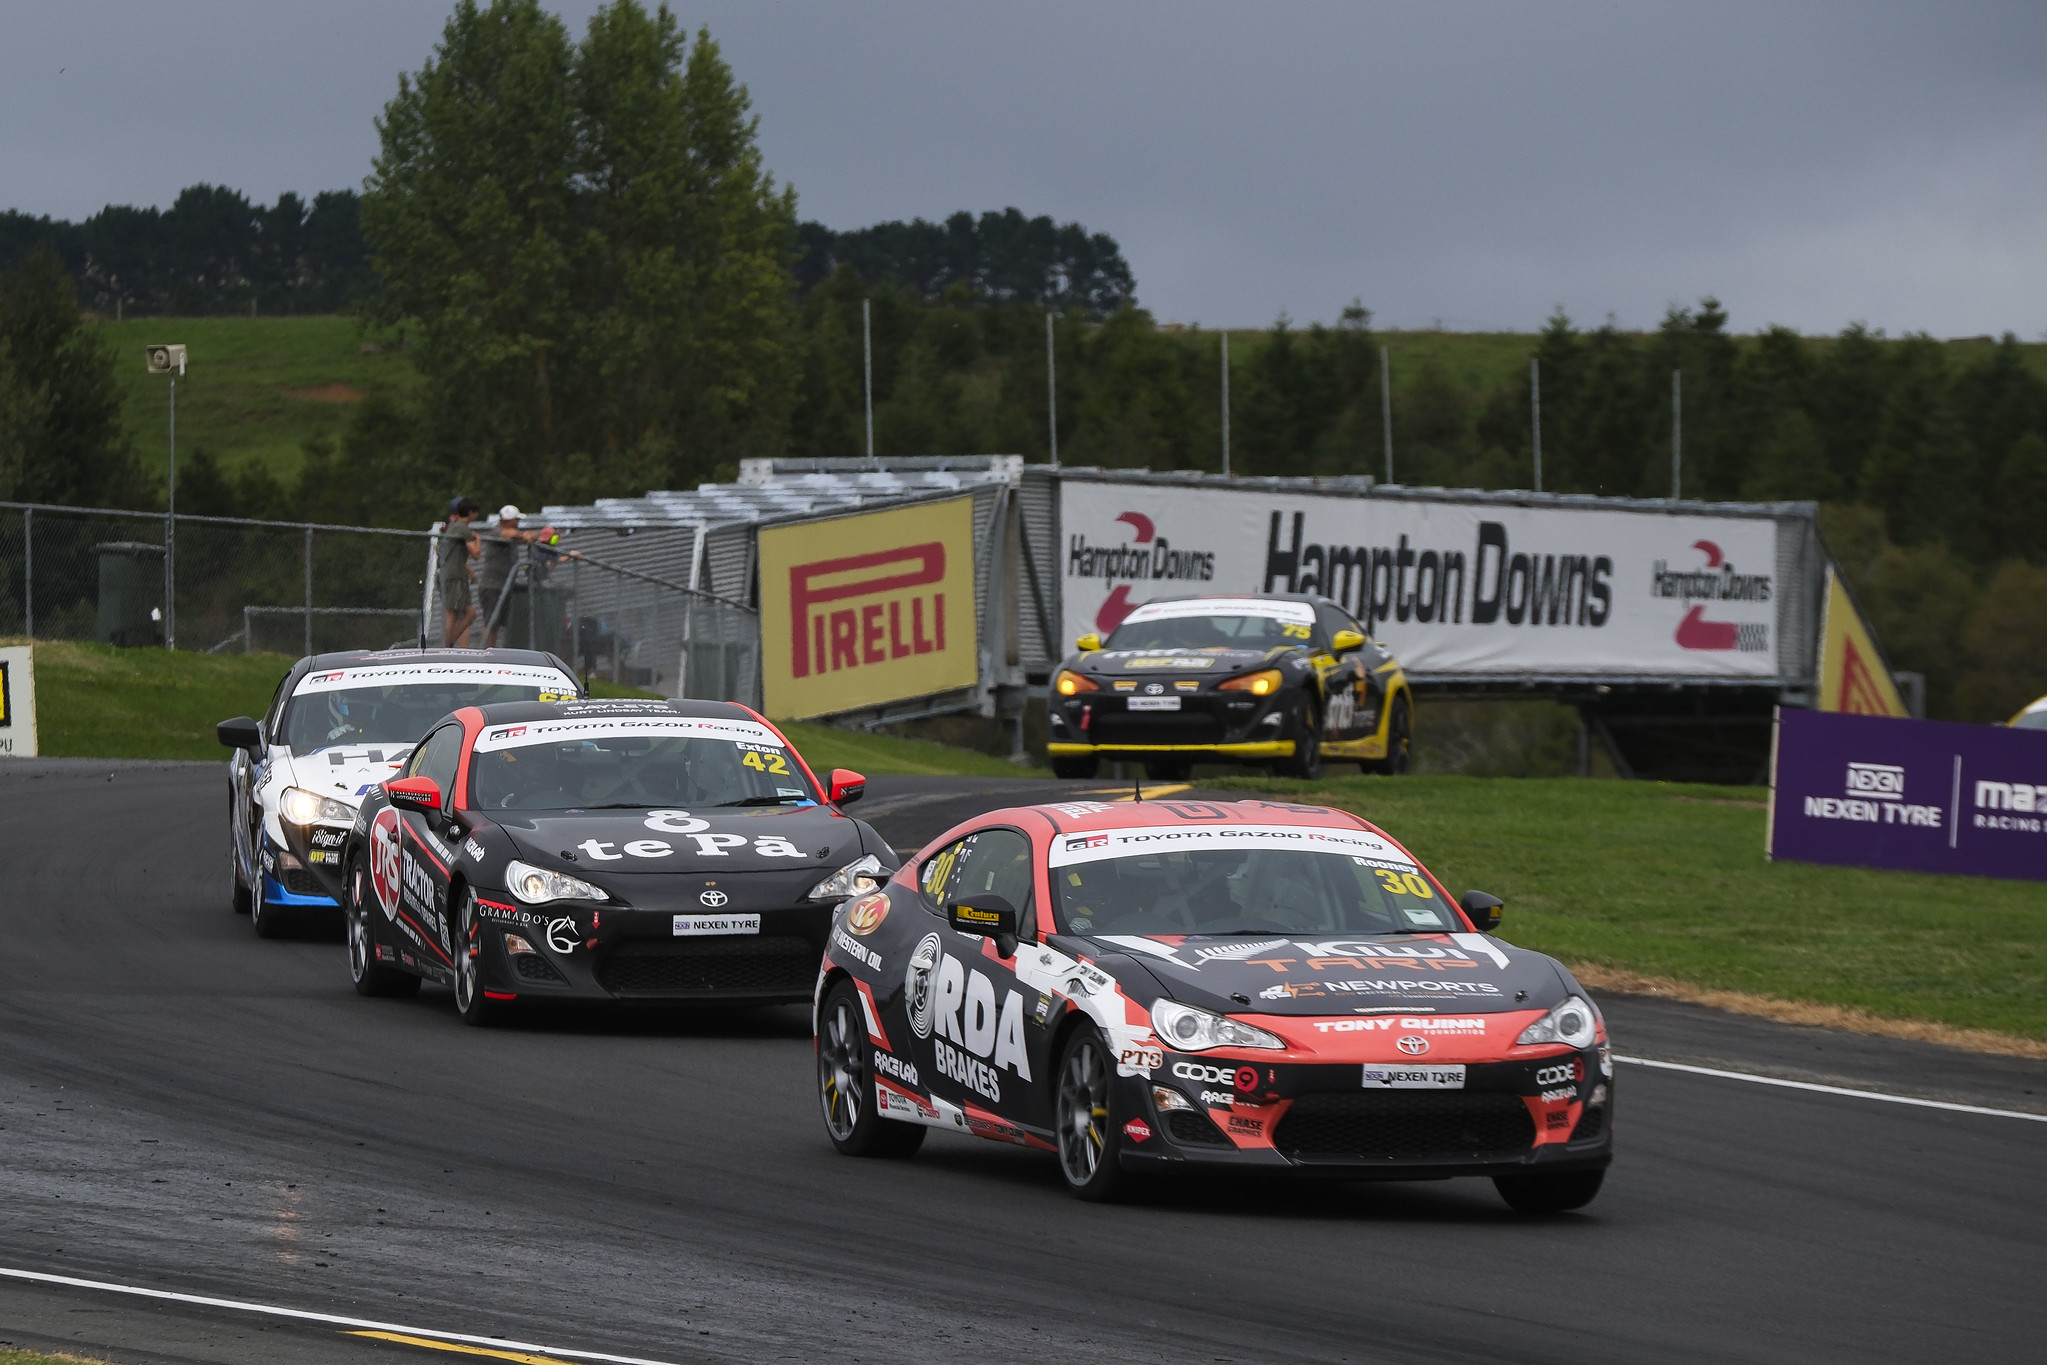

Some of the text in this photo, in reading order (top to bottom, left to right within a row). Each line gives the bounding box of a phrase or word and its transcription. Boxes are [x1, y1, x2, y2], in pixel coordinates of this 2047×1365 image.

[1068, 533, 1216, 590] Hampton Downs
[1264, 510, 1614, 638] Hampton Downs
[1651, 559, 1771, 608] Hampton Downs
[790, 541, 946, 679] PIRELLI
[1281, 623, 1311, 640] 75
[350, 668, 422, 679] TOYOTA
[427, 667, 493, 675] GAZOO
[497, 669, 558, 681] Racing
[540, 686, 578, 697] Robb
[566, 703, 669, 711] BAYLEYS
[489, 721, 763, 741] GR TOYOTA GAZOO Racing
[735, 742, 781, 755] Exton
[742, 751, 790, 776] 42
[1804, 796, 1942, 828] NEXEN TYRE
[1973, 813, 2041, 833] RACING
[577, 838, 675, 861] te
[1066, 830, 1383, 852] GR TOYOTA GAZOO Racing
[926, 852, 955, 894] 30
[1352, 856, 1419, 876] Rooney
[402, 847, 436, 912] TRACTOR
[1375, 869, 1434, 899] 30
[480, 904, 550, 926] GRAMADO'S
[957, 905, 999, 921] Century
[693, 920, 729, 930] NEXEN
[730, 919, 759, 930] TYRE
[837, 930, 870, 963] WESTERN
[867, 951, 883, 973] OIL
[1293, 941, 1471, 960] KIWI
[1245, 958, 1480, 972] TARP
[1323, 980, 1500, 993] NEWPORTS
[934, 952, 1033, 1083] RDA
[1313, 1018, 1485, 1032] TONY QUINN
[934, 1038, 1000, 1104] BRAKES
[1172, 1062, 1255, 1088] CODE 9
[1387, 1071, 1429, 1082] NEXEN
[1431, 1071, 1464, 1082] TYRE
[1536, 1063, 1575, 1086] CODE
[1126, 1125, 1152, 1137] KNIPEX
[1227, 1125, 1262, 1138] GRAPHICS
[1230, 1115, 1264, 1130] CHASE
